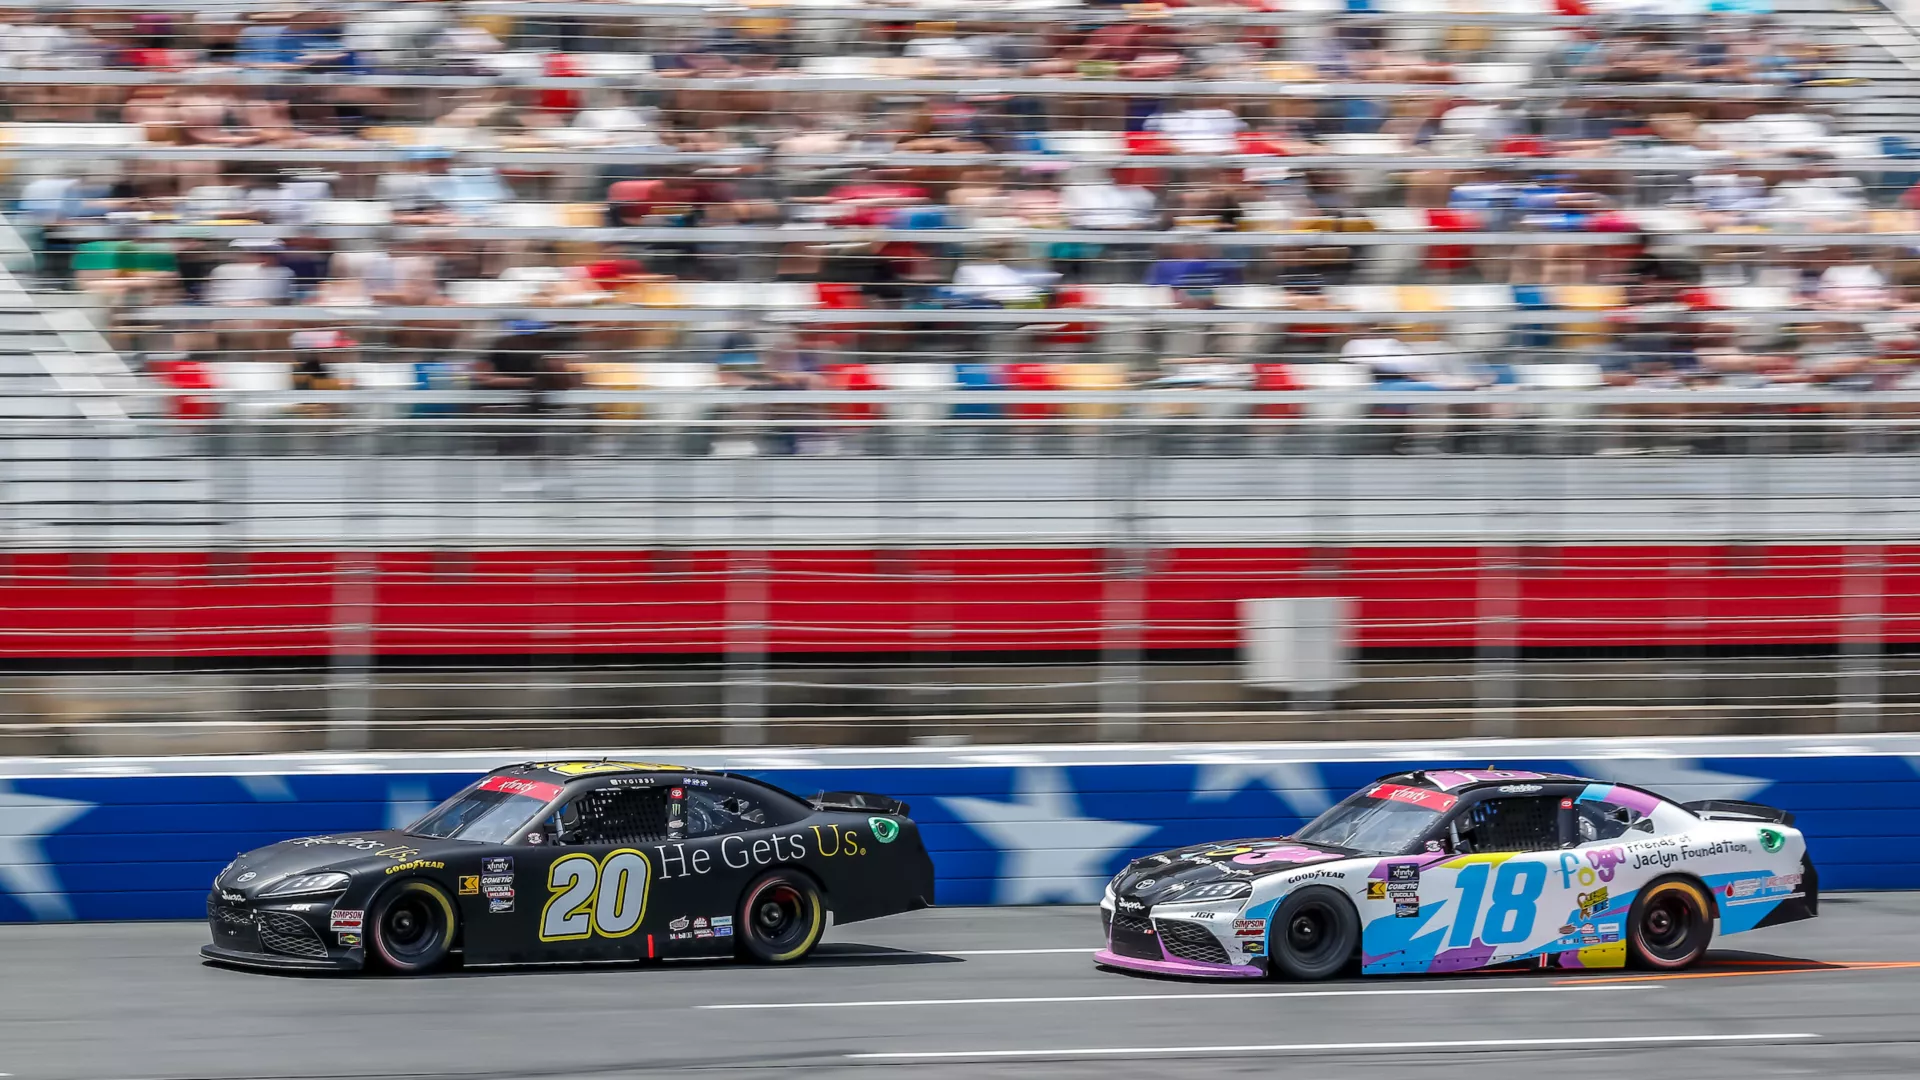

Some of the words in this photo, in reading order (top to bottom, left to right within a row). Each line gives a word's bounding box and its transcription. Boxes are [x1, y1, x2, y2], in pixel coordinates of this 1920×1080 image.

[498, 780, 537, 792] xfinity
[1389, 787, 1430, 803] xfinity
[654, 843, 712, 880] He
[721, 833, 806, 869] Gets
[809, 824, 866, 858] Us.
[1627, 837, 1675, 853] Friends
[385, 859, 445, 875] GOODYEAR
[487, 862, 509, 871] xfinity
[1632, 850, 1678, 869] Jaclyn
[482, 876, 513, 884] COMETIC
[1288, 869, 1345, 884] GOODYEAR
[1393, 869, 1414, 878] xfinity
[539, 848, 651, 942] 20
[1118, 897, 1146, 912] Supra
[1450, 861, 1547, 945] 18
[332, 911, 362, 919] SIMPSON
[1190, 912, 1216, 920] JGR
[1235, 920, 1264, 928] SIMPSON
